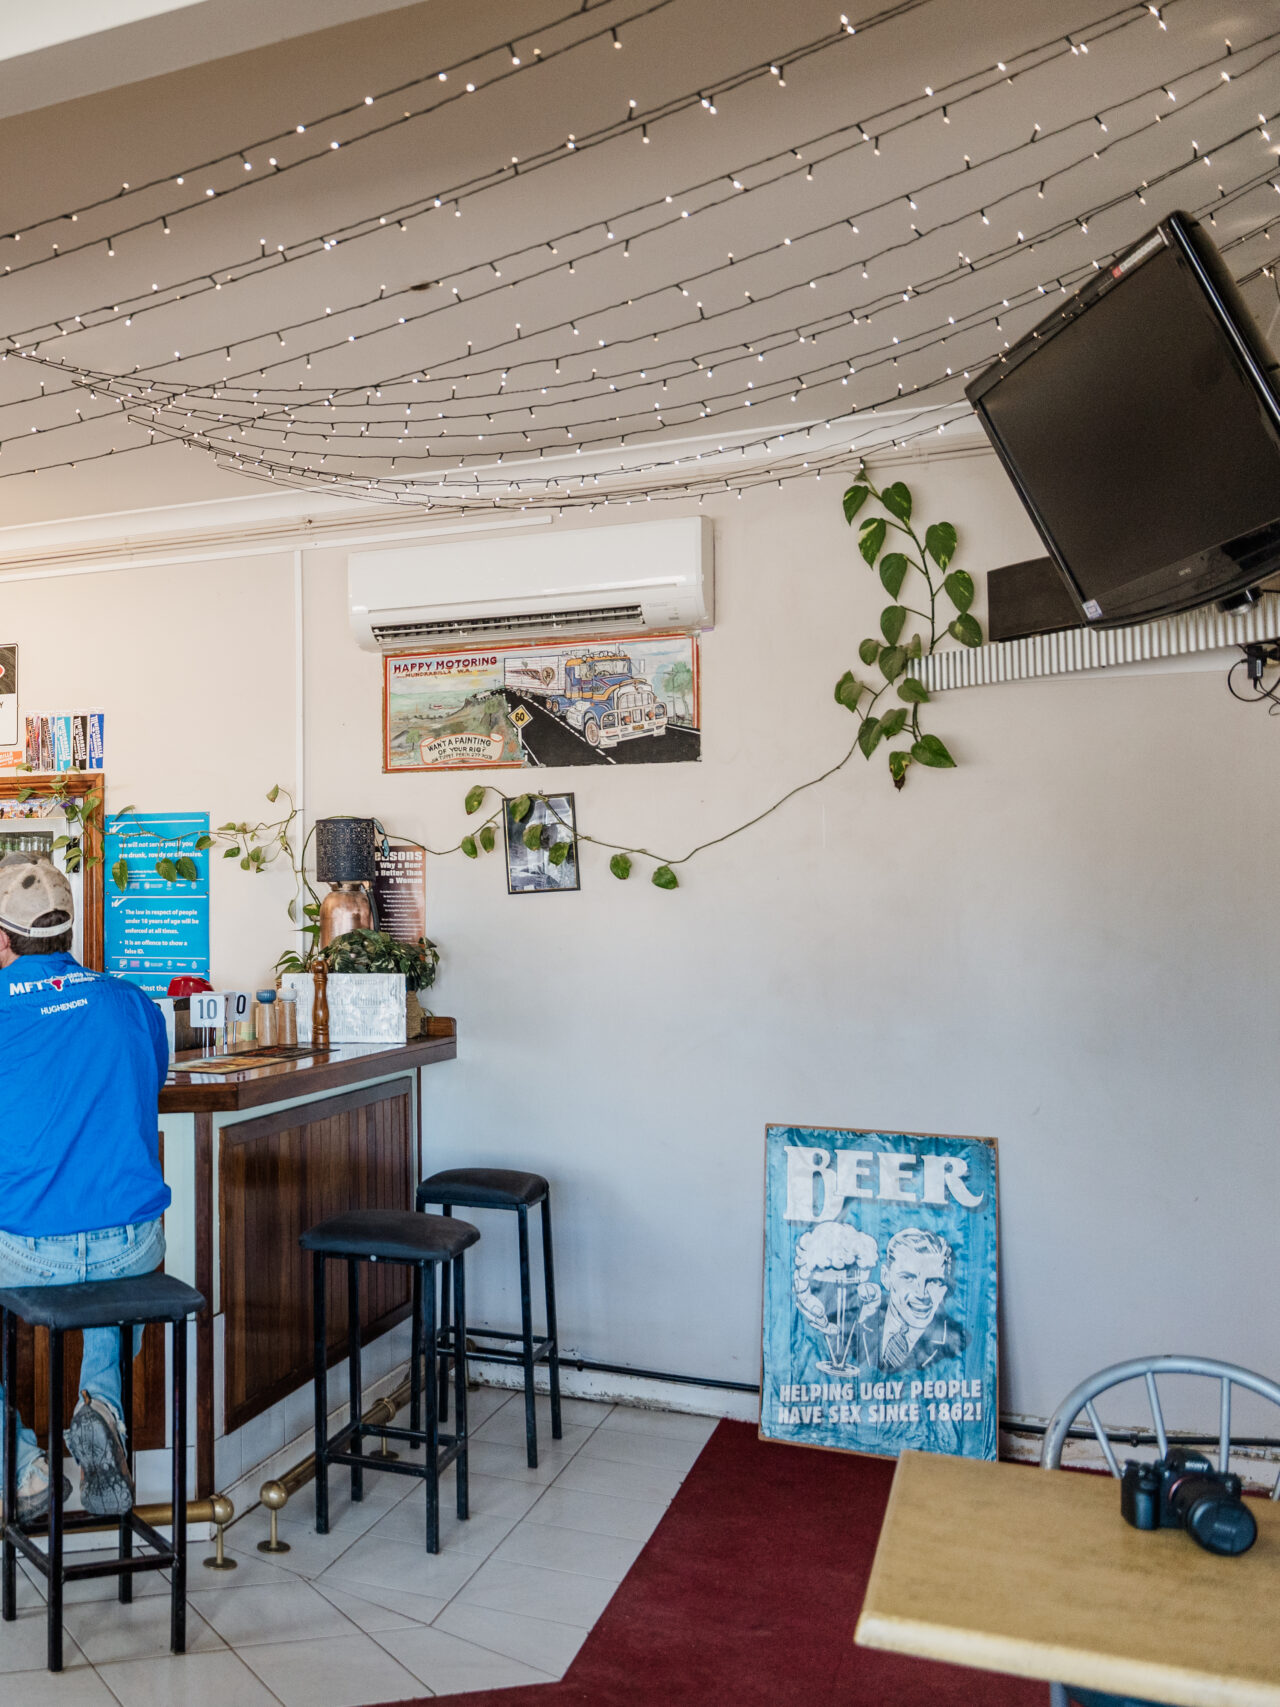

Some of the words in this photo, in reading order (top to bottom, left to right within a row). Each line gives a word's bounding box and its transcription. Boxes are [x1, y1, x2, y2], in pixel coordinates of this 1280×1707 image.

[393, 662, 432, 674] HAPPY
[436, 657, 497, 670] MOTORING
[515, 713, 525, 722] 60
[427, 740, 446, 751] WANT
[455, 737, 491, 746] PAINTING
[10, 982, 43, 995] MFT
[41, 998, 88, 1015] HUGHENDEN
[198, 999, 217, 1019] 10
[783, 1145, 984, 1222] BEER
[779, 1382, 854, 1402] HELPING
[860, 1381, 904, 1400] UGLY
[910, 1380, 981, 1399] PEOPLE
[778, 1406, 823, 1424] HAVE
[829, 1406, 862, 1424] SEX
[868, 1405, 919, 1423] SINCE
[927, 1403, 982, 1422] 1862!
